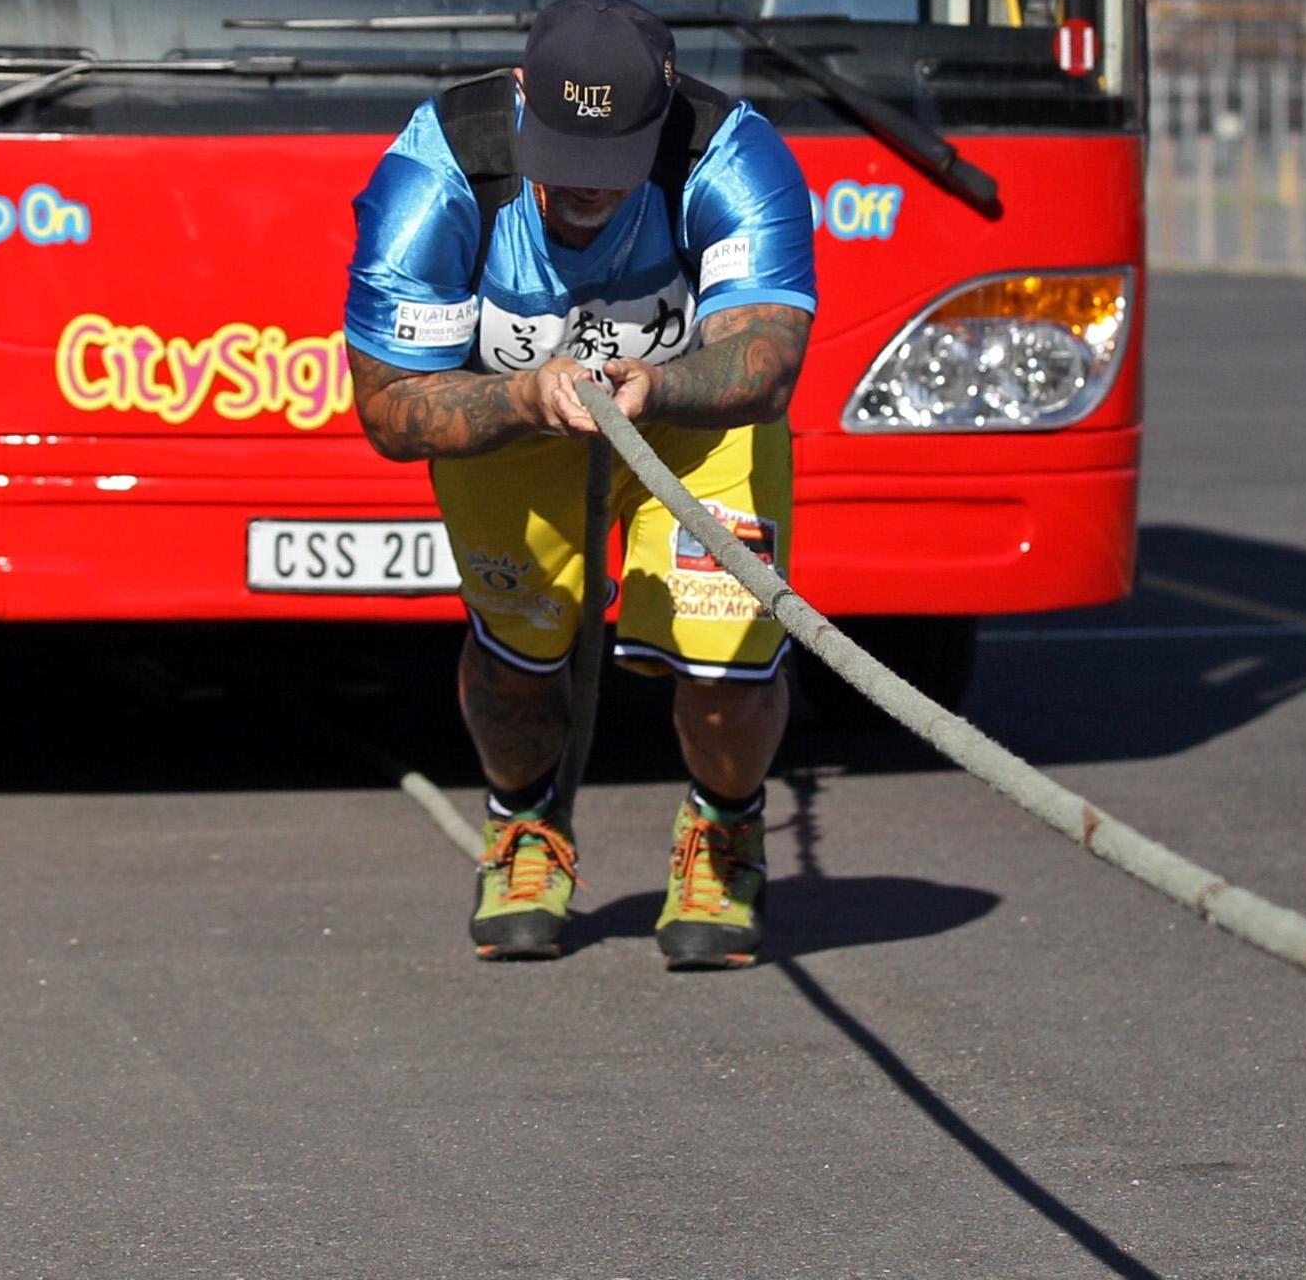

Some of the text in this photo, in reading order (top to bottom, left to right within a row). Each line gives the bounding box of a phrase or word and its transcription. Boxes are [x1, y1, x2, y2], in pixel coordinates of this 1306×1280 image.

[563, 80, 612, 106] BLITZ
[576, 101, 612, 117] bee
[22, 186, 89, 244] On
[827, 181, 901, 239] Off
[400, 304, 476, 322] EVALAR
[275, 532, 434, 578] CSS 20
